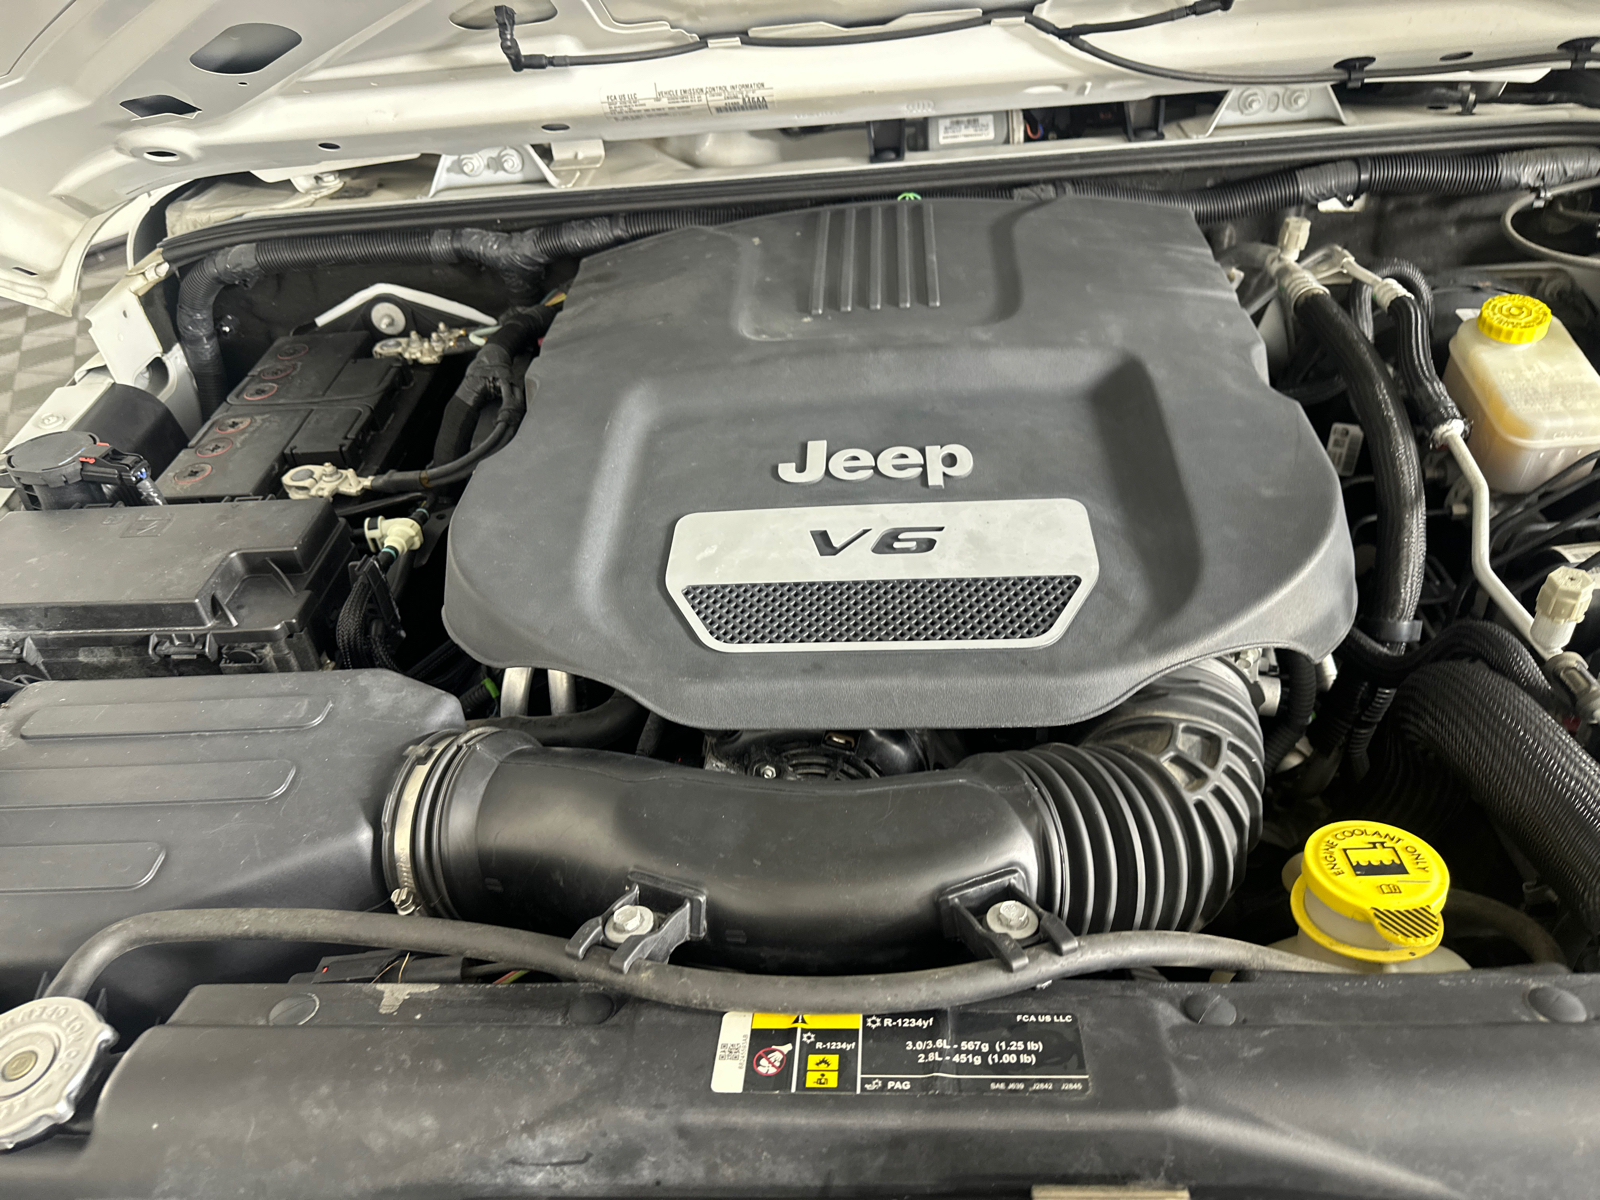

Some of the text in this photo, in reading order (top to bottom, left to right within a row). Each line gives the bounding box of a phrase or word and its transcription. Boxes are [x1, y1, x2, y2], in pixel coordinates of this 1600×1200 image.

[657, 89, 678, 97] VEHICLE
[679, 87, 704, 96] EMISSION
[705, 85, 727, 94] CONTROL
[730, 82, 765, 91] INFORMATION
[777, 439, 974, 489] Jeep
[809, 525, 946, 557] V6
[1322, 828, 1430, 876] ENGINE COOLANT ONLY
[883, 1016, 934, 1029] R-1234yf
[1053, 1014, 1073, 1022] LLC
[815, 1041, 857, 1050] R-1234yf
[906, 1039, 950, 1050] 3.0/3.6L
[960, 1040, 989, 1052] 567g
[995, 1041, 1024, 1052] (1.25
[1026, 1041, 1043, 1052] lb)
[917, 1052, 943, 1063] 2.8L
[952, 1054, 982, 1064] 451g
[988, 1054, 1017, 1065] (1.00
[1020, 1054, 1036, 1065] lb)
[887, 1082, 911, 1090] PAG
[990, 1082, 1006, 1090] SAE
